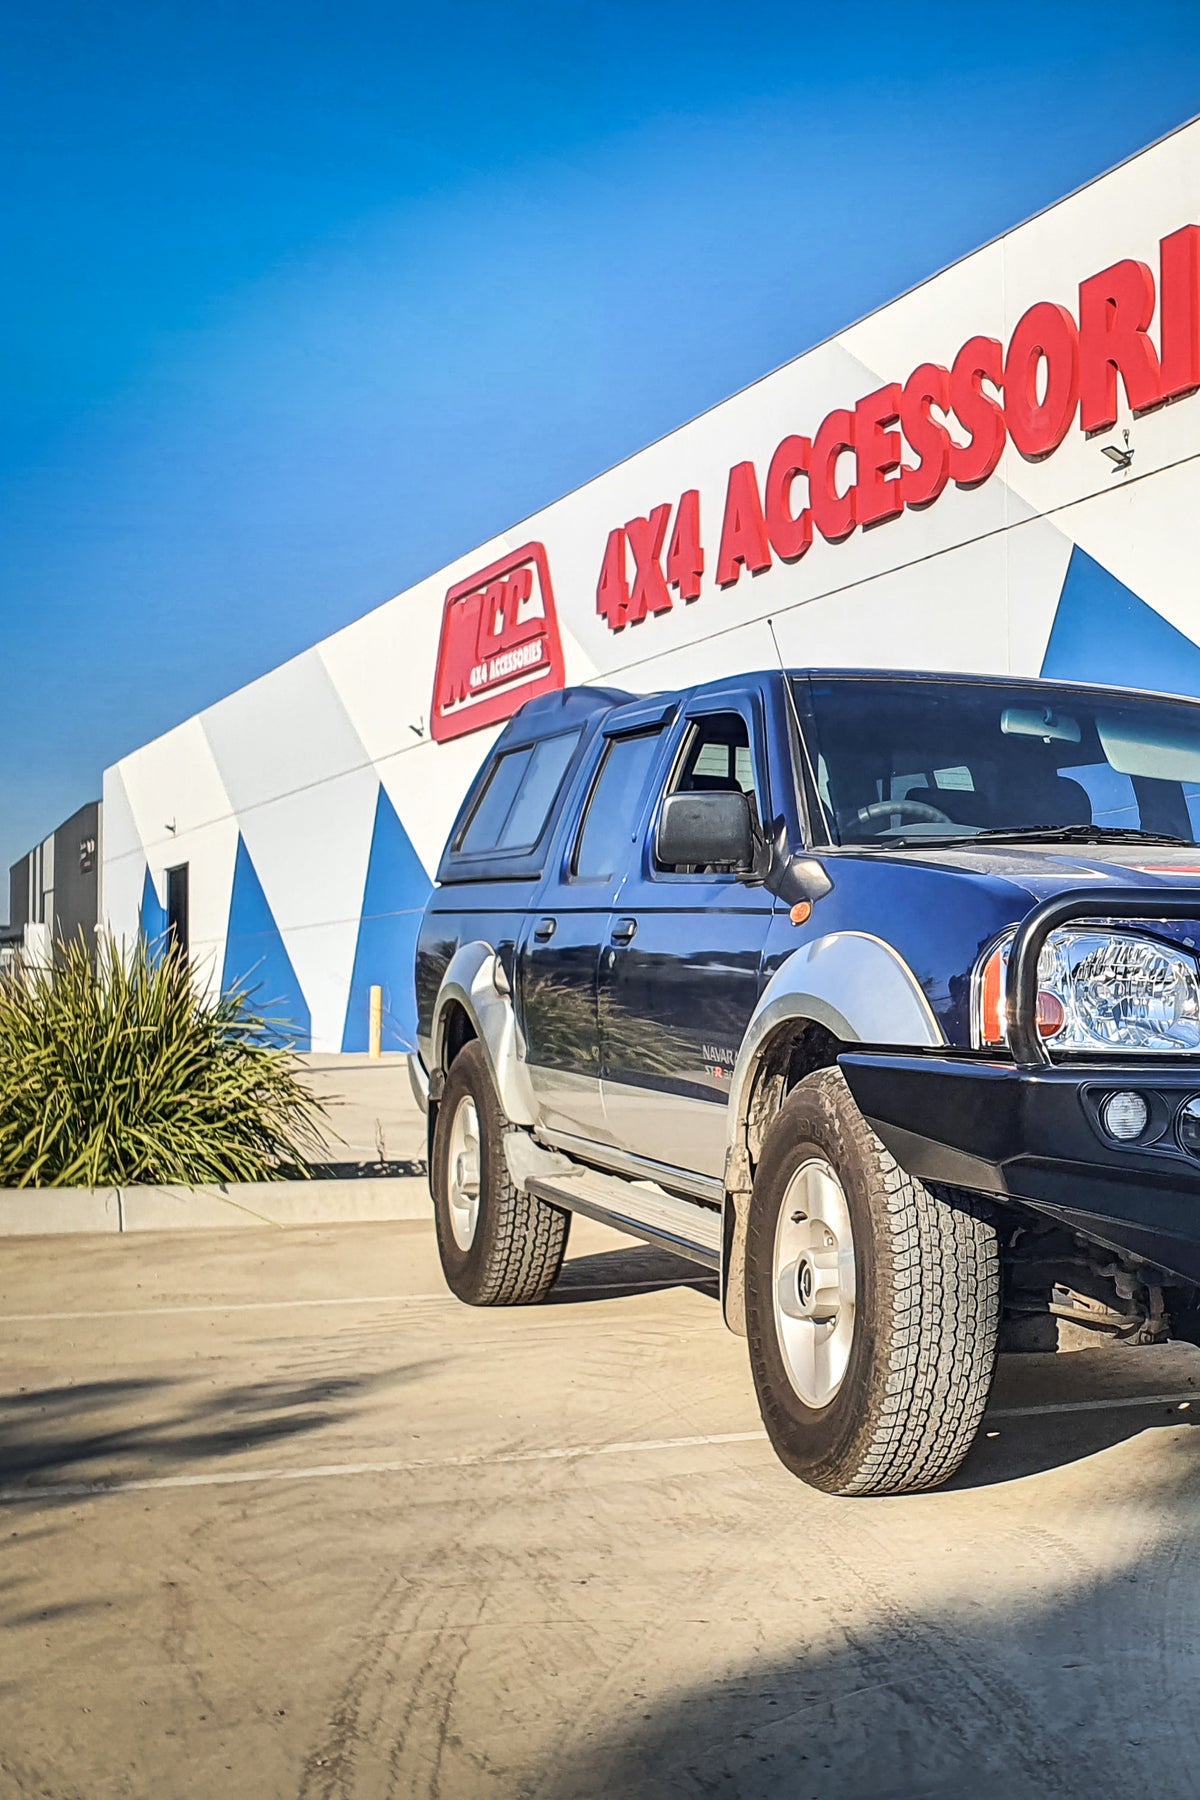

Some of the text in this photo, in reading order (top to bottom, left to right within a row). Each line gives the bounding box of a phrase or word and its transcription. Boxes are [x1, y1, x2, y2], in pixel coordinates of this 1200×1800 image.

[597, 488, 704, 632] 4X4
[443, 568, 547, 706] MCC
[469, 639, 543, 688] 4X4 ACCESSORIES
